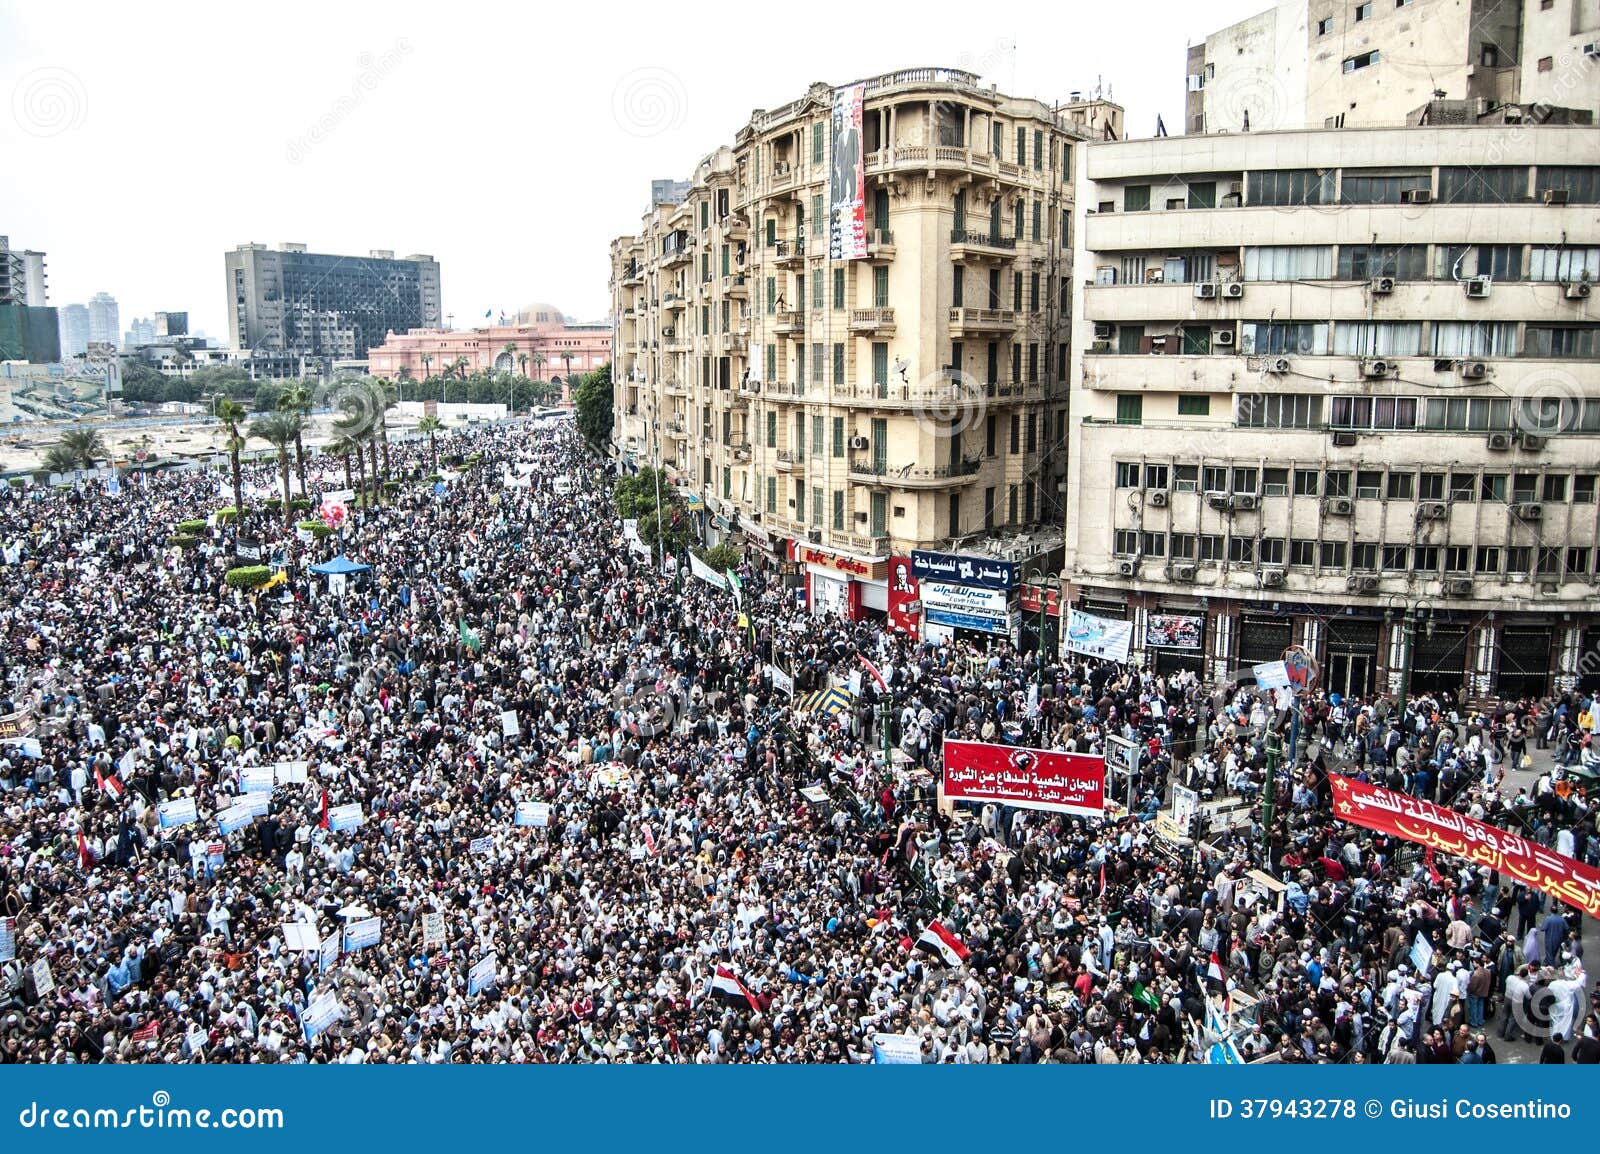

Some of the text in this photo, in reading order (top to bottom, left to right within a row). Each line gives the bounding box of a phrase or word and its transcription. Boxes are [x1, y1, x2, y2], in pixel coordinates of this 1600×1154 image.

[914, 555, 1009, 584] وندر للسياحة
[948, 766, 1099, 792] اللجان الشعبية للدفاع عن الثورة
[963, 784, 995, 794] للشعب
[997, 785, 1033, 798] والسلطة
[1061, 793, 1084, 802] النصر
[1352, 788, 1402, 813] للشعب
[1395, 818, 1503, 869] الثوريون
